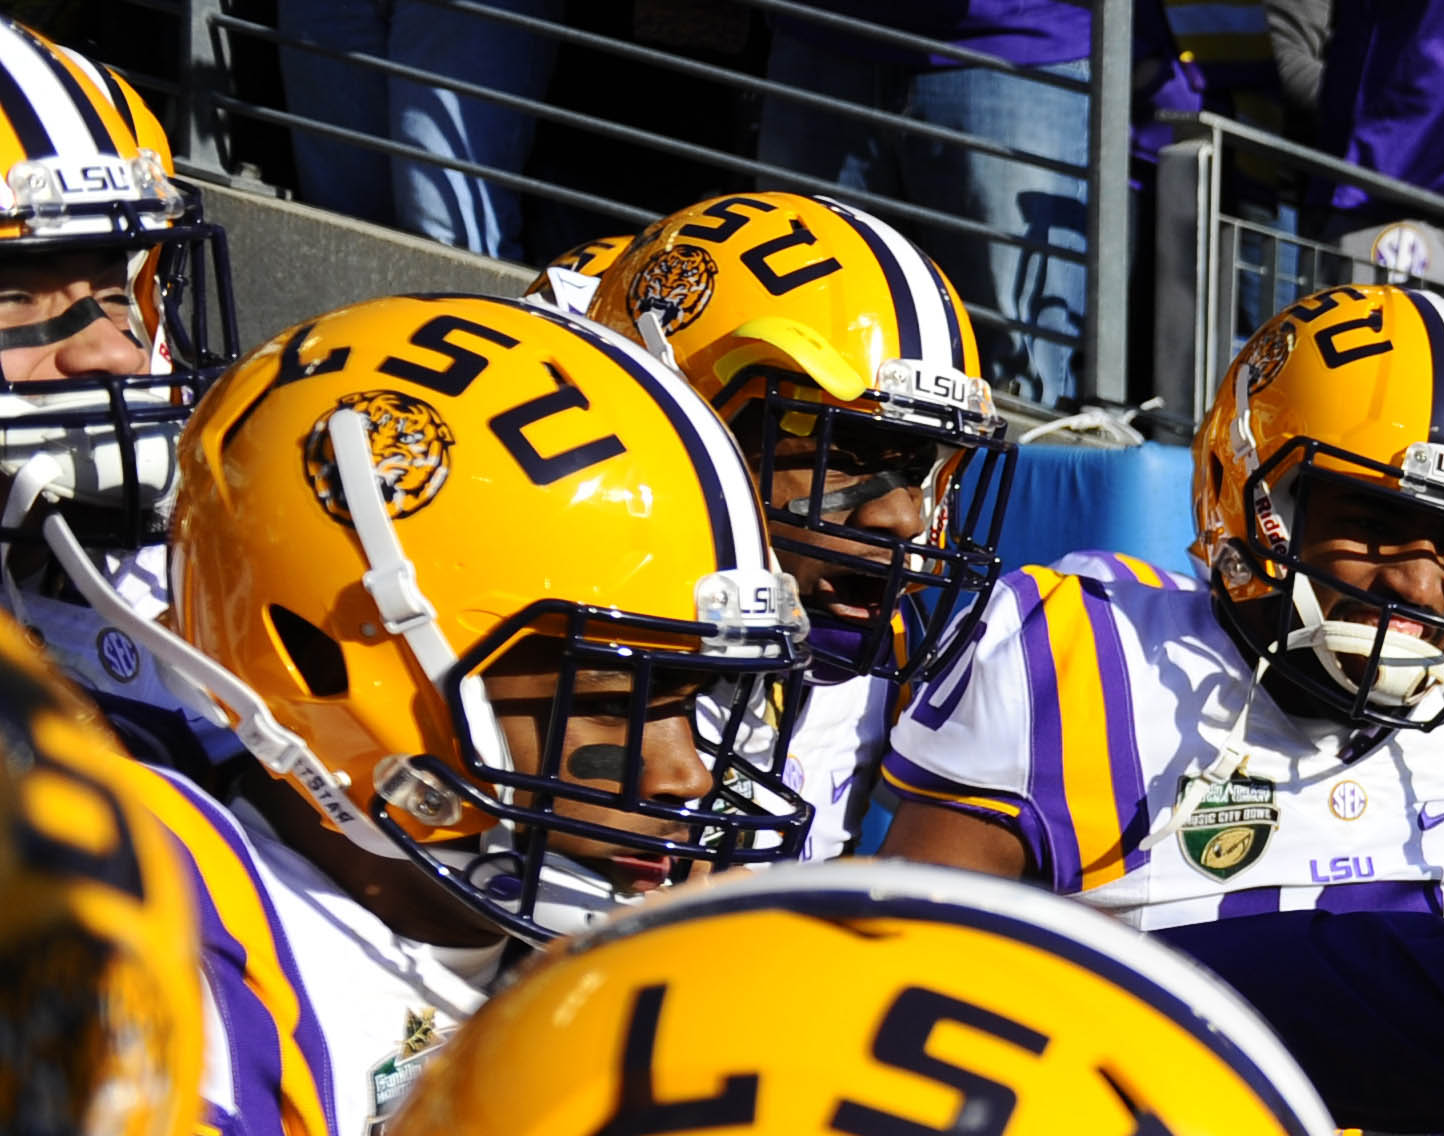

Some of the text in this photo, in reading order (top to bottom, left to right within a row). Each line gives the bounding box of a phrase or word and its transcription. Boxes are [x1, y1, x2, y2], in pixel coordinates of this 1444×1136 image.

[56, 166, 131, 193] LSU
[670, 196, 844, 297] SU
[245, 313, 628, 487] LSU
[916, 370, 965, 403] LSU
[104, 631, 137, 678] SEC
[1332, 783, 1367, 818] SEC
[1309, 856, 1375, 882] LSU
